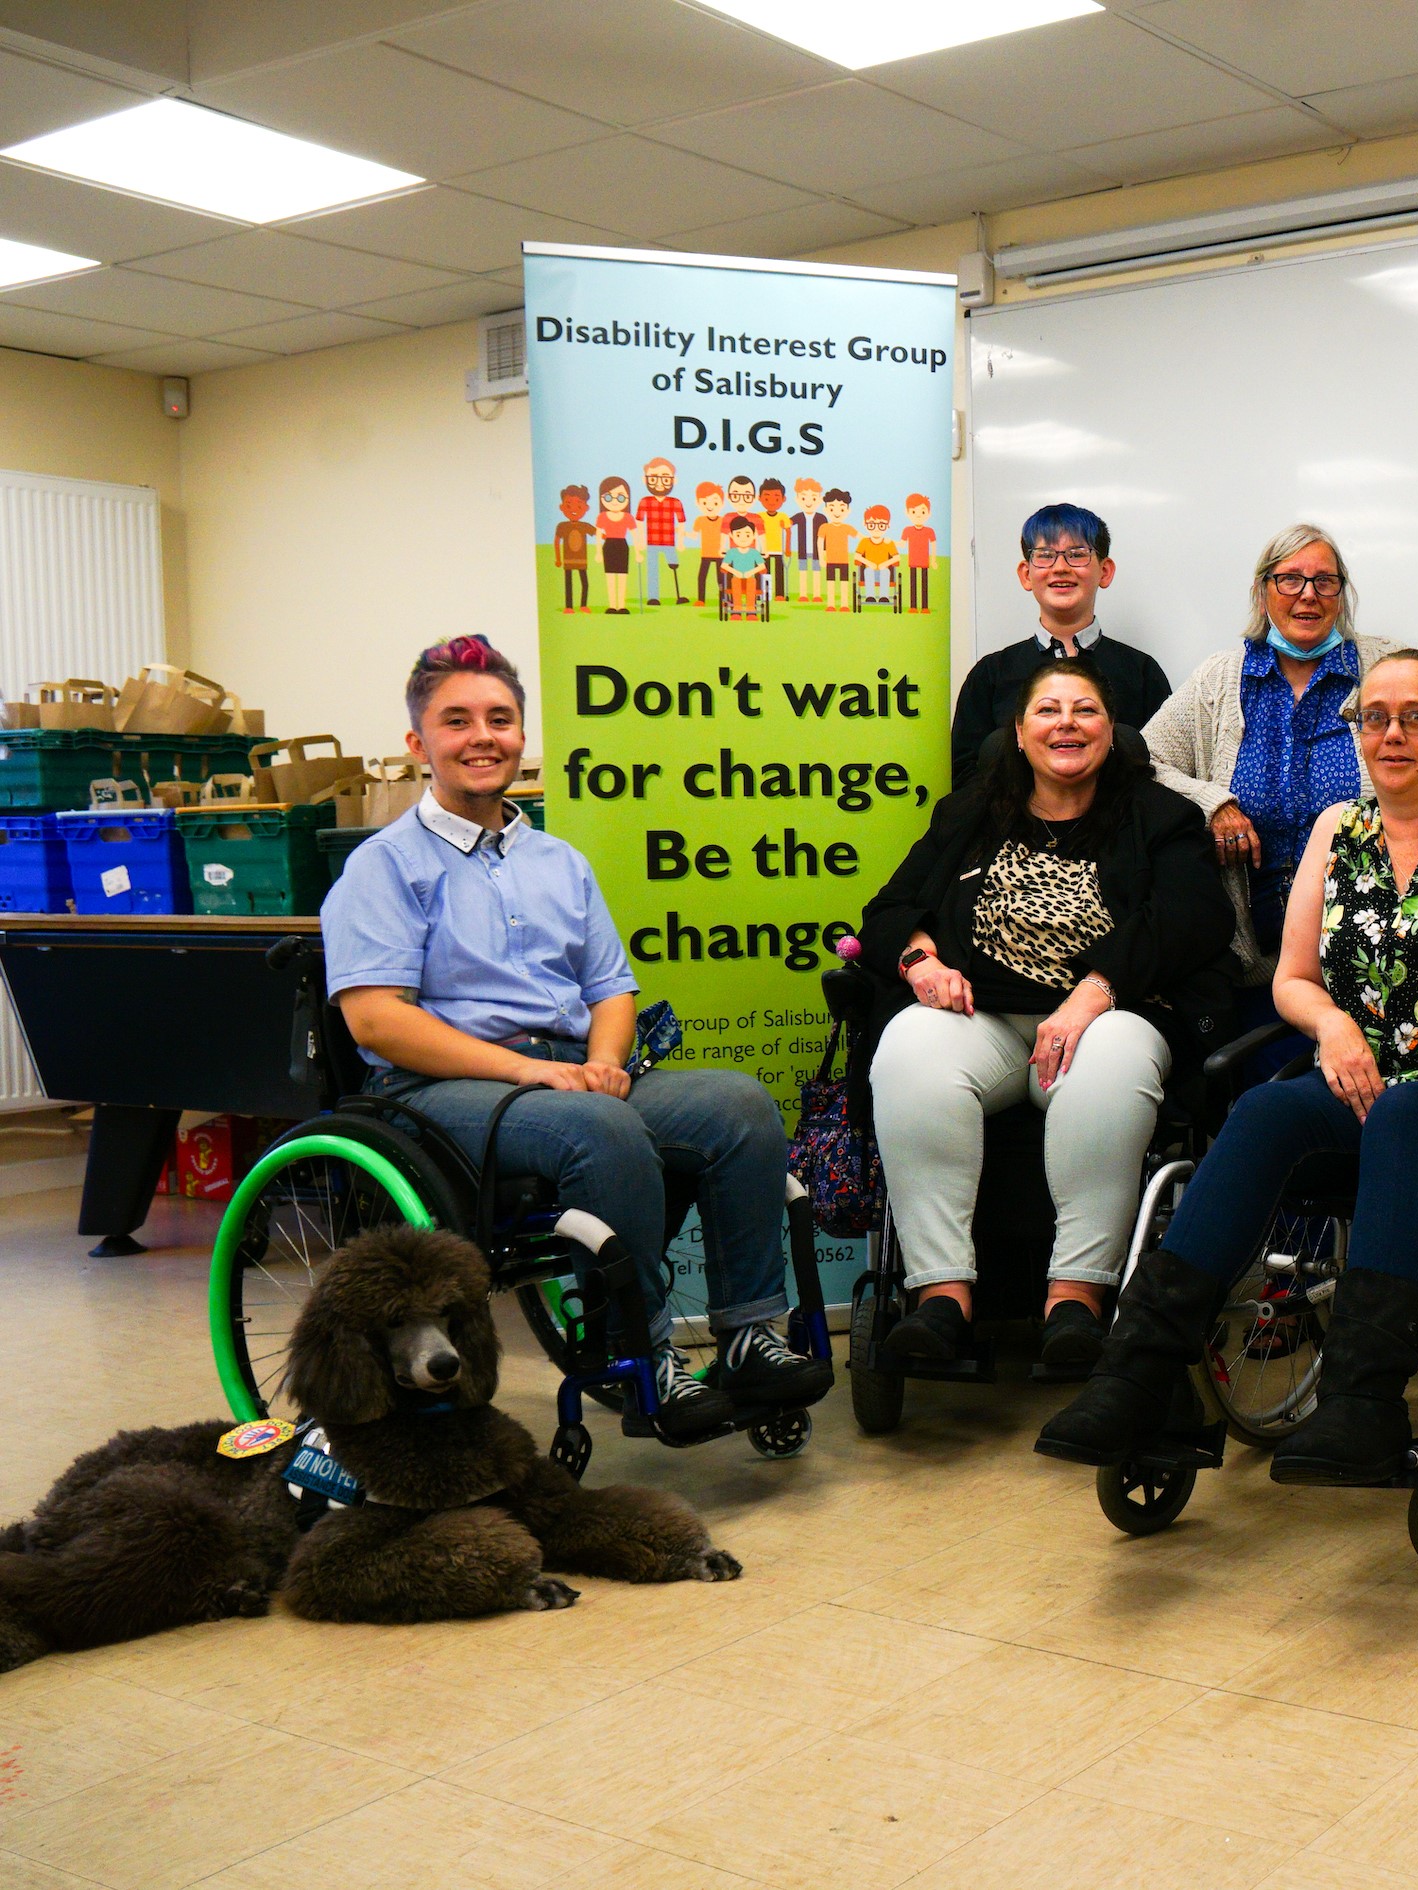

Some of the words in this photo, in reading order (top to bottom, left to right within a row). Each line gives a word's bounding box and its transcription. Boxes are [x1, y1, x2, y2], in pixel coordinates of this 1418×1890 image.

[536, 316, 695, 357] Disability
[707, 326, 837, 360] Interest
[847, 335, 948, 373] Group
[651, 367, 686, 393] of
[694, 368, 844, 408] Salisbury
[673, 415, 825, 456] D.I.G.S
[575, 664, 762, 717] Don't
[782, 668, 920, 718] wait
[563, 747, 661, 799] for
[683, 747, 930, 812] change,
[646, 829, 731, 881] Be
[751, 827, 859, 877] the
[629, 911, 858, 971] change
[679, 1016, 730, 1034] roup
[736, 1010, 758, 1029] of
[763, 1008, 832, 1028] Salisbur
[703, 1045, 755, 1063] range
[761, 1038, 782, 1056] of
[756, 1067, 785, 1084] for
[815, 1246, 856, 1264] 0562
[293, 1449, 315, 1470] DO
[309, 1454, 339, 1480] NOT
